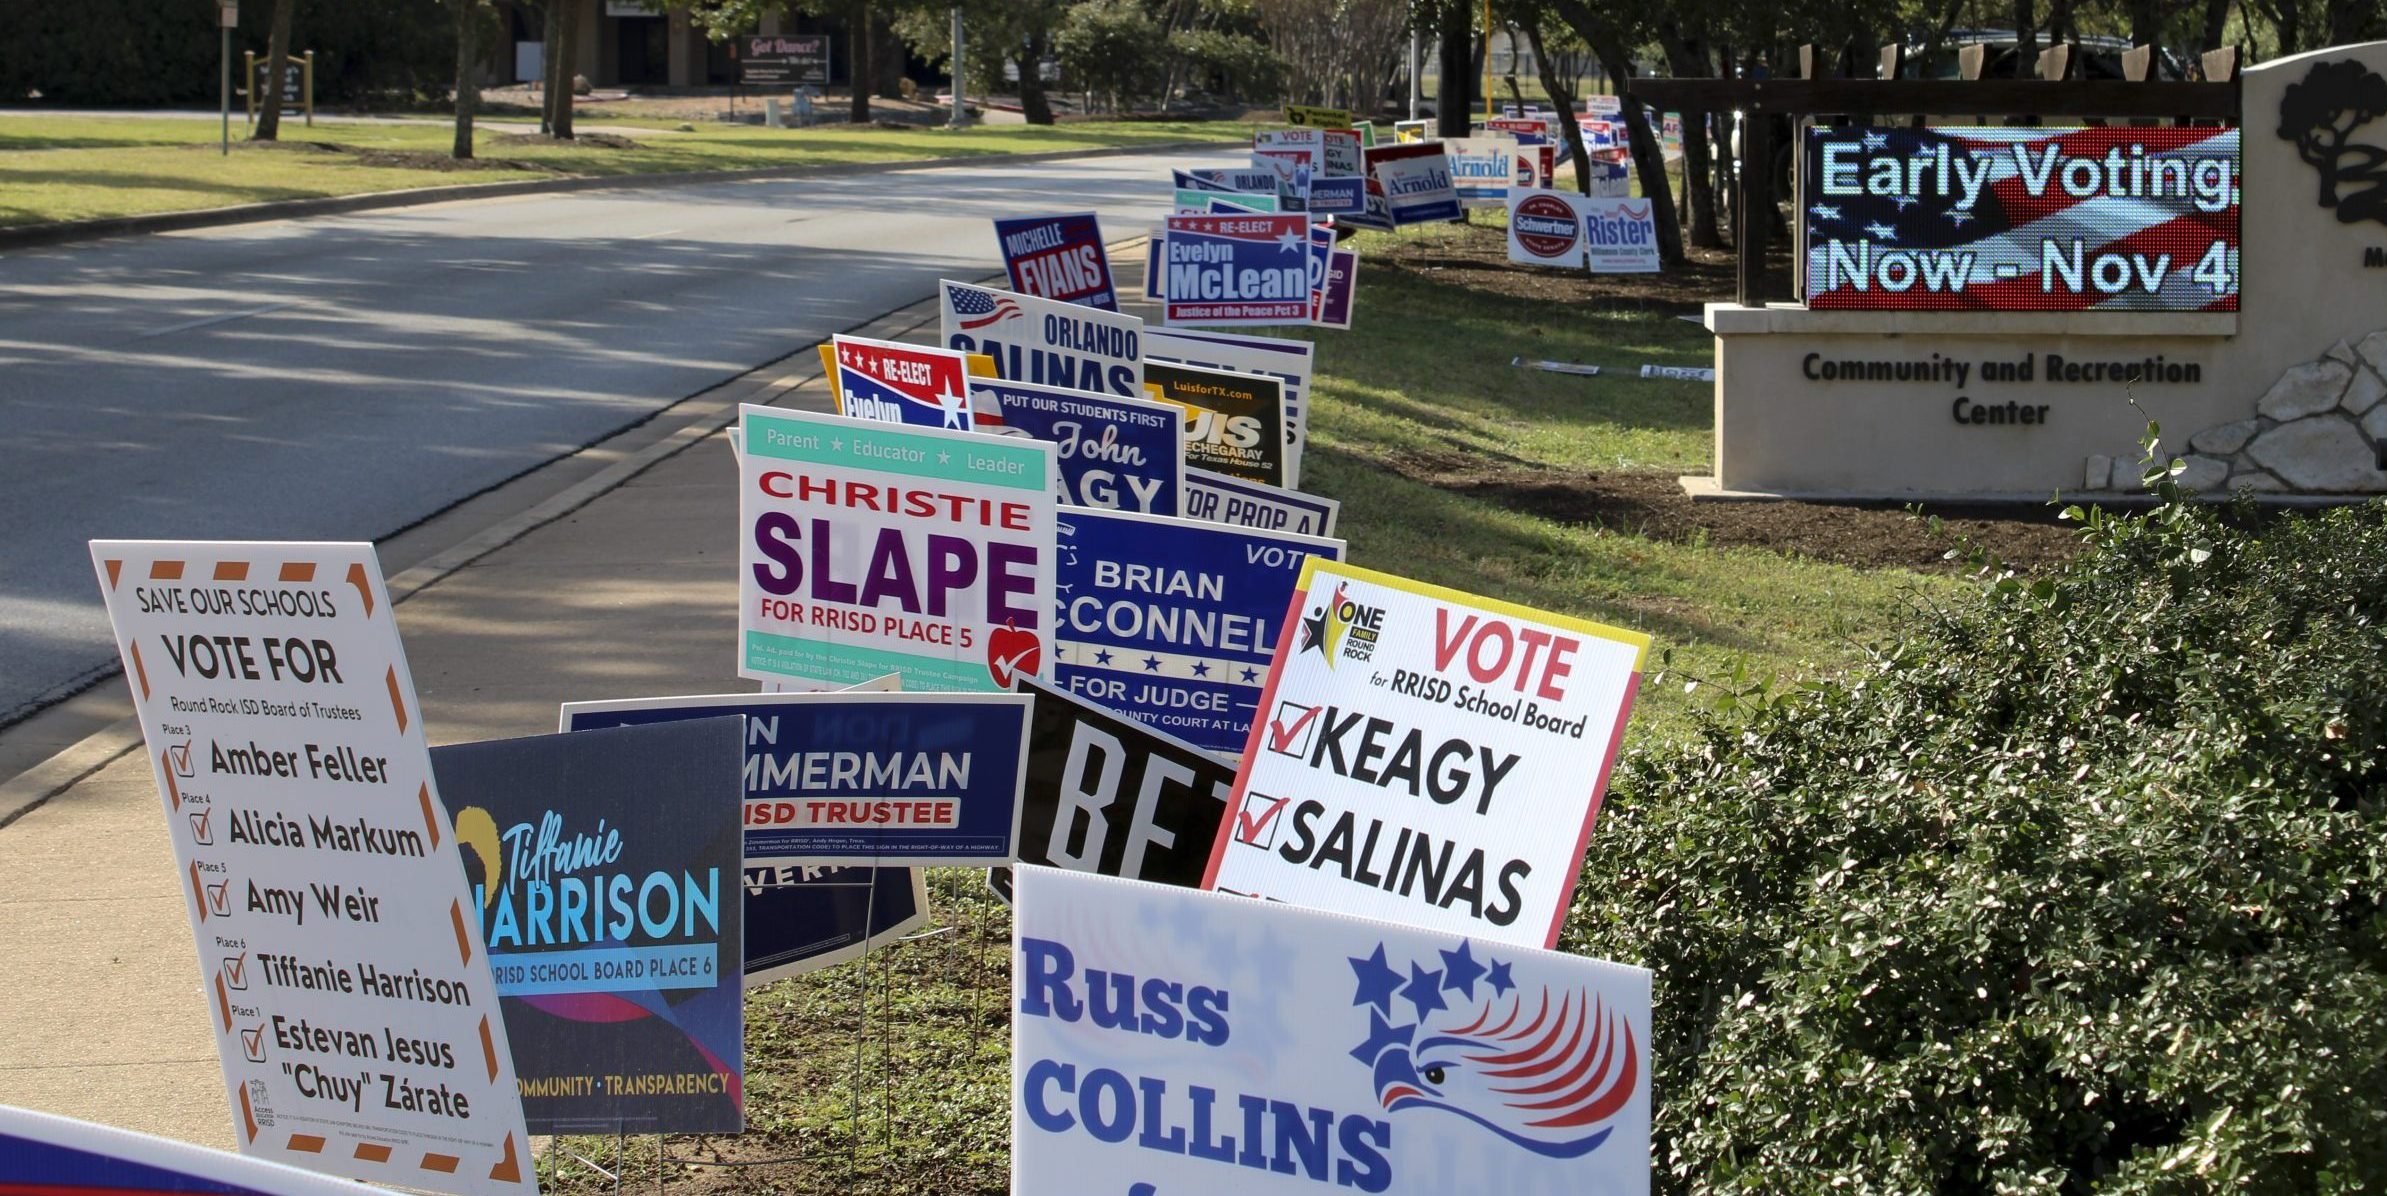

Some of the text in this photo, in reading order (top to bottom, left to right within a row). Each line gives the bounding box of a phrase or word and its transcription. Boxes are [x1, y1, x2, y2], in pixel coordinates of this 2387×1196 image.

[1281, 131, 1313, 141] VOTE
[1449, 144, 1508, 178] Arnold
[1822, 142, 2232, 212] Early Voting
[1235, 175, 1276, 190] ORLANDO
[1390, 167, 1449, 195] Arnold
[1006, 223, 1064, 257] MICHELLE
[1220, 221, 1273, 234] RE-ELECT
[1516, 216, 1574, 236] Schwertner
[1586, 215, 1652, 245] Rister
[1170, 241, 1233, 263] Evelyn
[1828, 238, 1978, 295] Now
[2041, 240, 2170, 295] Nov
[2193, 240, 2231, 295] 4
[1018, 244, 1102, 298] EVANS
[1170, 263, 1305, 300] McLean
[1176, 304, 1299, 318] Justice of the Peace Pct 3
[1045, 313, 1138, 362] ORLANDO
[882, 358, 932, 386] RE-ELECT
[950, 334, 1134, 398] ALINAS
[1802, 352, 2201, 388] Community and Recreation
[1174, 381, 1252, 400] LuisforTX.com
[1003, 395, 1166, 429] PUT OUR STUDENTS FIRST
[1952, 397, 2050, 426] Center
[766, 428, 1025, 476] Parent Educator Leader
[1052, 421, 1147, 467] John
[1202, 454, 1230, 464] Texas
[1230, 458, 1260, 468] House
[1261, 462, 1273, 470] 52
[758, 470, 1032, 532] CHRISTIE
[1224, 497, 1288, 531] PROP
[1296, 514, 1310, 536] A
[752, 512, 1038, 630] SLAPE
[1093, 560, 1224, 601] BRIAN
[136, 587, 337, 619] SAVE OUR SCHOOLS
[1340, 601, 1386, 631] ONE
[760, 598, 973, 648] FOR RRISD PLACE 5
[1352, 628, 1376, 641] FAMILY
[160, 634, 344, 685] VOTE FOR
[1343, 648, 1372, 662] ROCK
[1346, 638, 1375, 652] ROUND
[1435, 608, 1580, 702] VOTE
[170, 696, 362, 722] Round Rock ISD Board of Trustees
[1069, 676, 1230, 713] FOR JUDGE
[1370, 669, 1588, 739] for RRISD School Board
[162, 723, 191, 736] Place 3
[745, 716, 779, 746] N
[1162, 715, 1209, 728] COURT
[1212, 720, 1230, 730] AT
[210, 738, 388, 785] Amber Feller
[1310, 705, 1522, 816] KEAGY
[181, 792, 211, 804] Place 4
[806, 802, 954, 824] TRUSTEE
[1045, 718, 1234, 890] BE
[230, 809, 425, 858] Alicia Markum
[812, 838, 826, 846] Andy
[197, 860, 226, 873] Place 5
[501, 809, 623, 895] Tiffanie
[1279, 799, 1533, 926] SALINAS
[247, 877, 380, 926] Amy Weir
[216, 936, 246, 949] Place 6
[256, 953, 471, 1007] Tiffanie Harrison
[491, 958, 712, 985] RISD SCHOOL BOARD PLACE 6
[1020, 937, 1231, 1048] Russ
[232, 1005, 260, 1017] Place 1
[271, 1014, 456, 1070] Estevan Jesus
[282, 1063, 470, 1120] "Chuy" Zárate
[604, 1072, 730, 1096] TRANSPARENCY
[258, 1118, 274, 1127] RRISD
[1023, 1058, 1392, 1194] COLLINS
